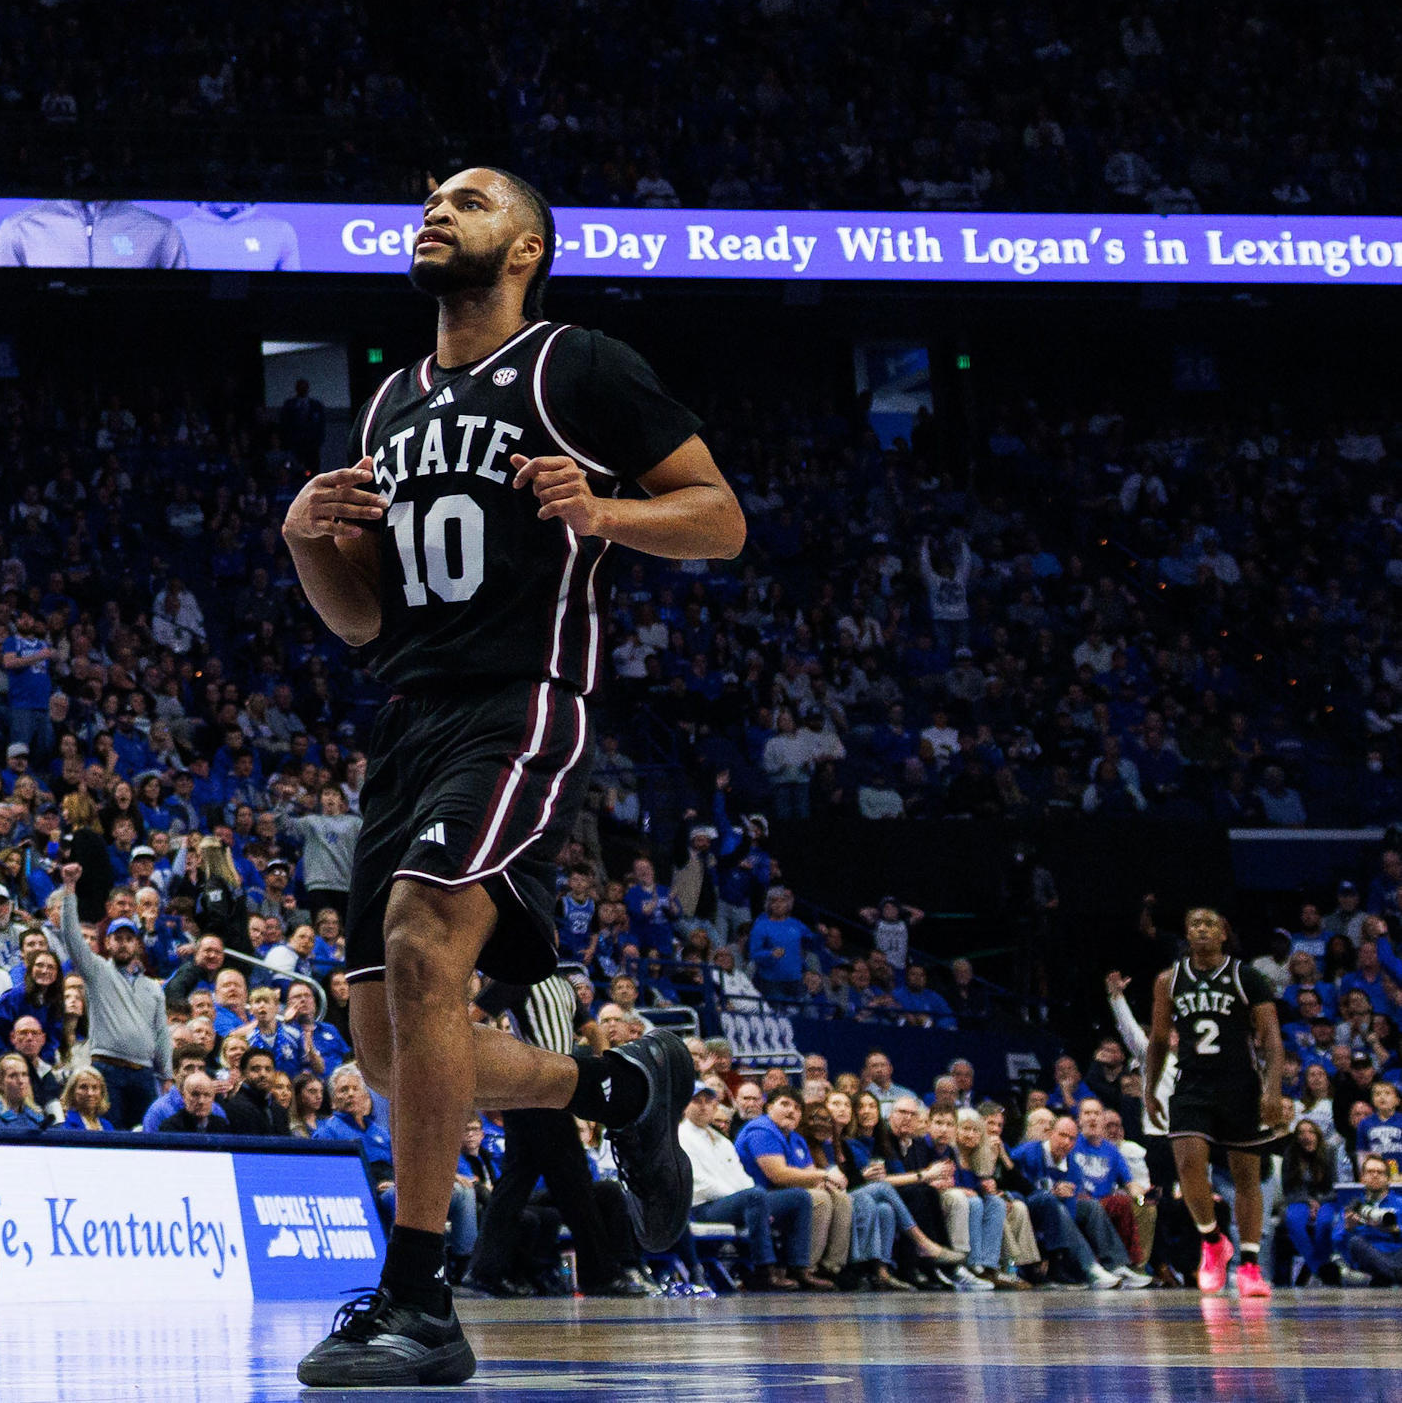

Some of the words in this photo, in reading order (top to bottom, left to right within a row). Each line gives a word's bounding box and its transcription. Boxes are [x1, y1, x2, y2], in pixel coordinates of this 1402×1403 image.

[341, 219, 414, 257] Get
[688, 225, 818, 273] Ready
[837, 225, 945, 265] With
[963, 227, 1127, 276] Logan's
[1143, 229, 1190, 265] in
[372, 414, 525, 508] STATE
[387, 493, 485, 608] 10
[1173, 989, 1237, 1018] STATE
[1193, 1018, 1222, 1055] 2
[252, 1194, 314, 1226] BUCKLE
[320, 1195, 368, 1227] PHONE
[43, 1196, 238, 1280] Kentucky.
[297, 1228, 323, 1260] UP
[330, 1229, 376, 1260] DOWN
